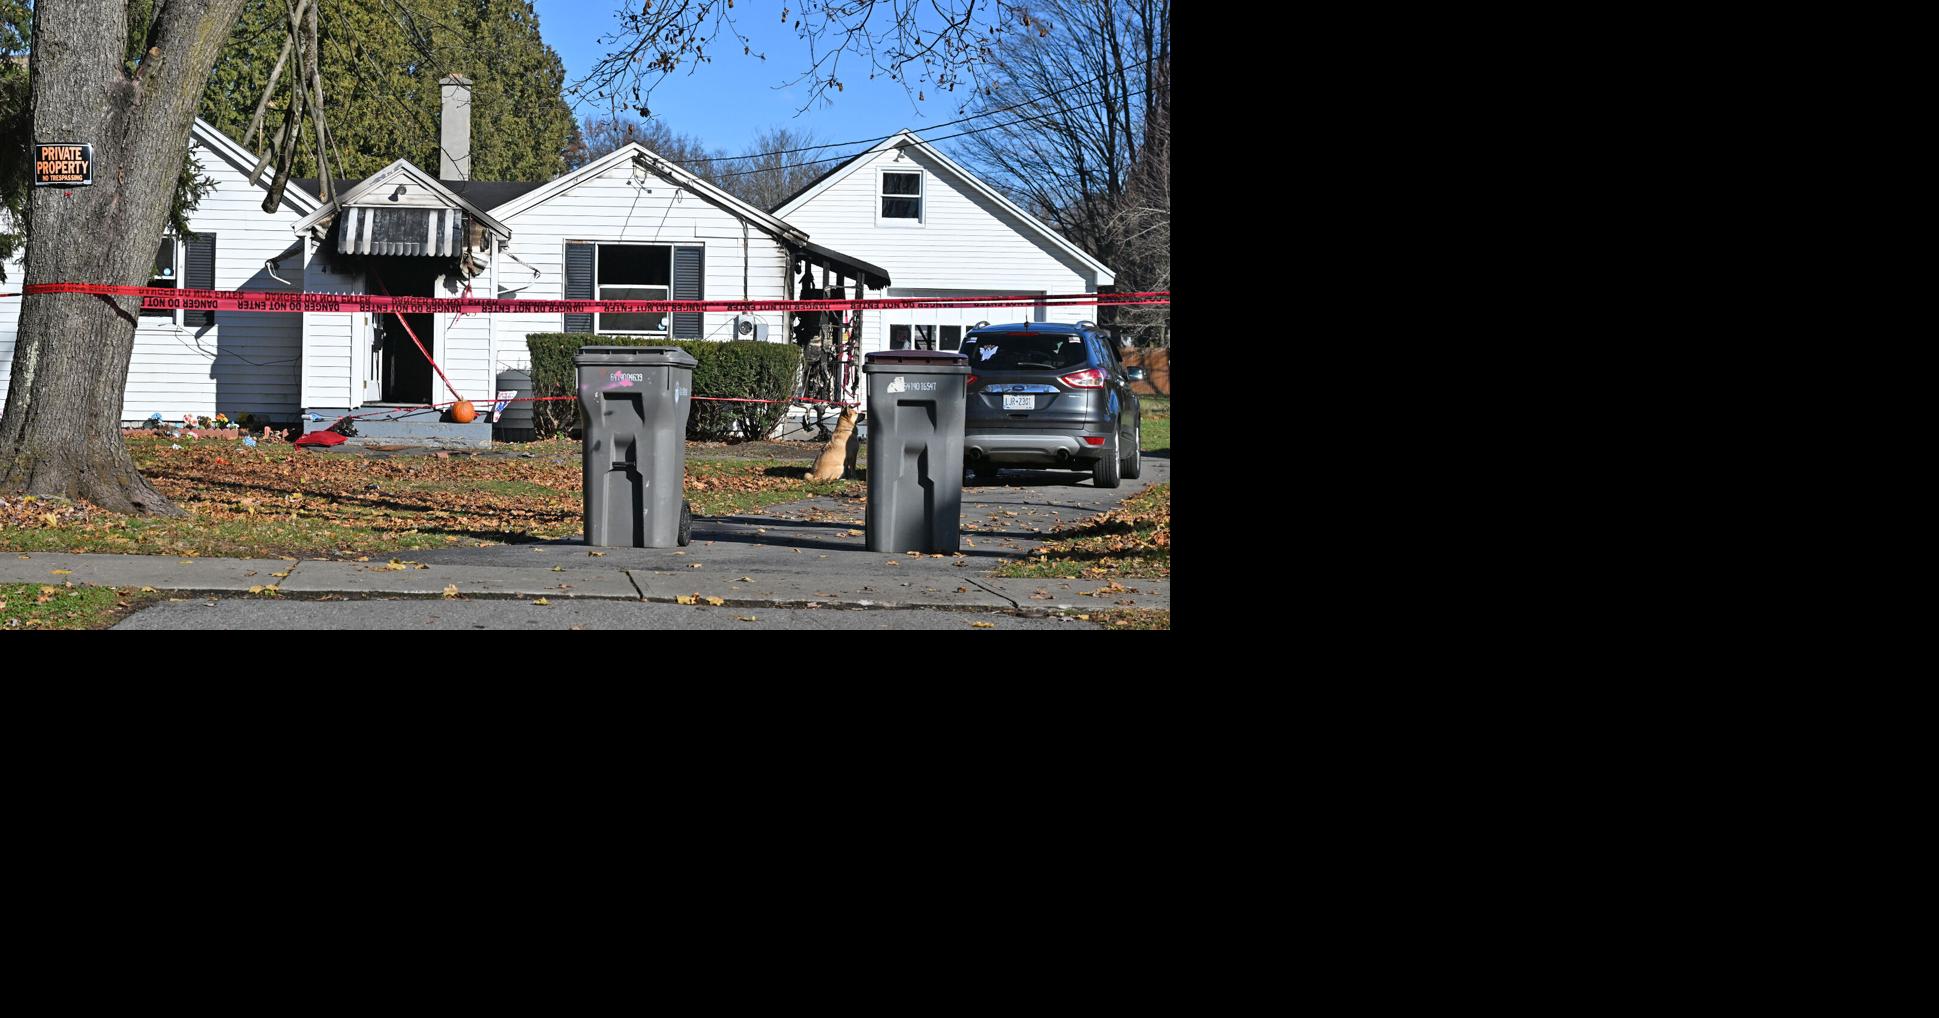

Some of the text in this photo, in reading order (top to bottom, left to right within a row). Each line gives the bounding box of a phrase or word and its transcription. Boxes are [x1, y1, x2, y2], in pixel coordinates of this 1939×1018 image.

[42, 146, 83, 161] PRIVATE
[36, 161, 89, 174] PROPERTY
[147, 298, 219, 309] DANGER DO NOT
[237, 300, 340, 312] DANGER DO NOT ENTER
[360, 304, 461, 313] DANGER DO NOT ENTER
[481, 304, 584, 313] DANGER DO NOT ENTER
